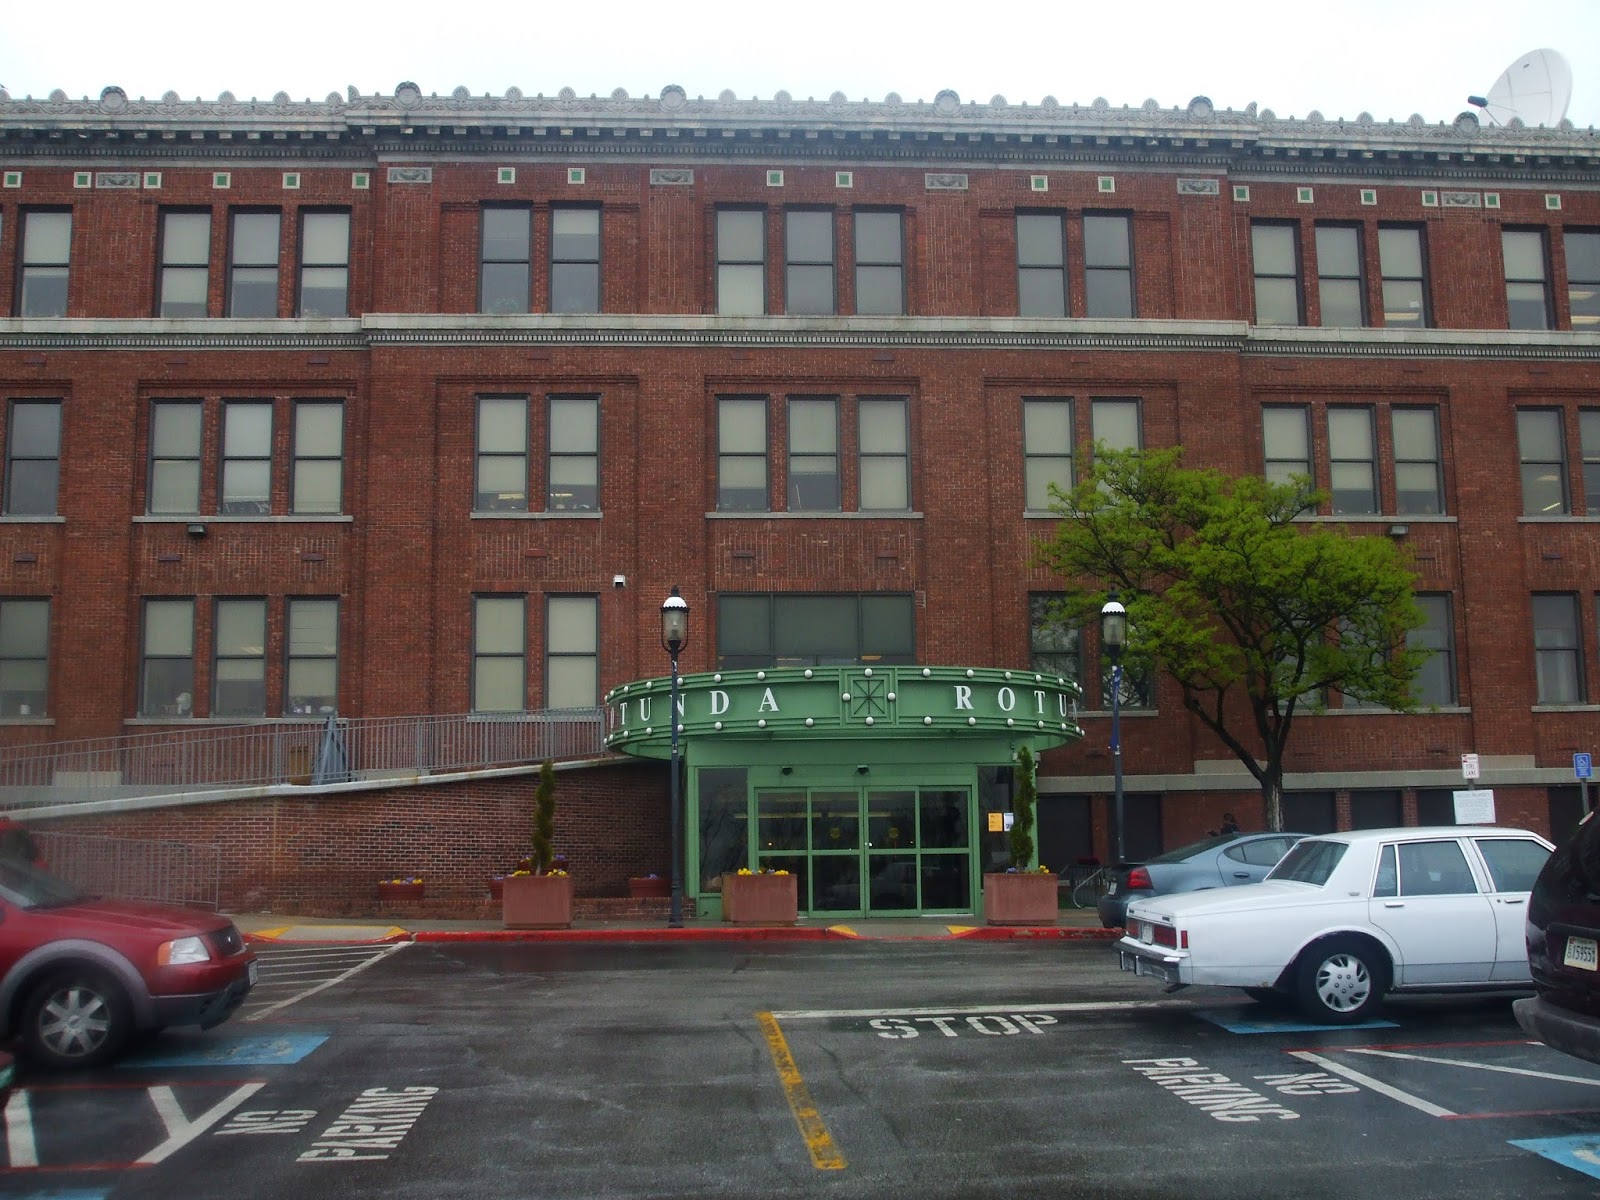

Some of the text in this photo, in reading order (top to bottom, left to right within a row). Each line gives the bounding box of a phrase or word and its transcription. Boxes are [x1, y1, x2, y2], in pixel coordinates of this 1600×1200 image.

[868, 1014, 1059, 1039] STOP
[1121, 1057, 1301, 1122] PARKING
[1253, 1072, 1361, 1095] NO
[213, 1109, 319, 1136] NO
[295, 1086, 440, 1163] PARKING
